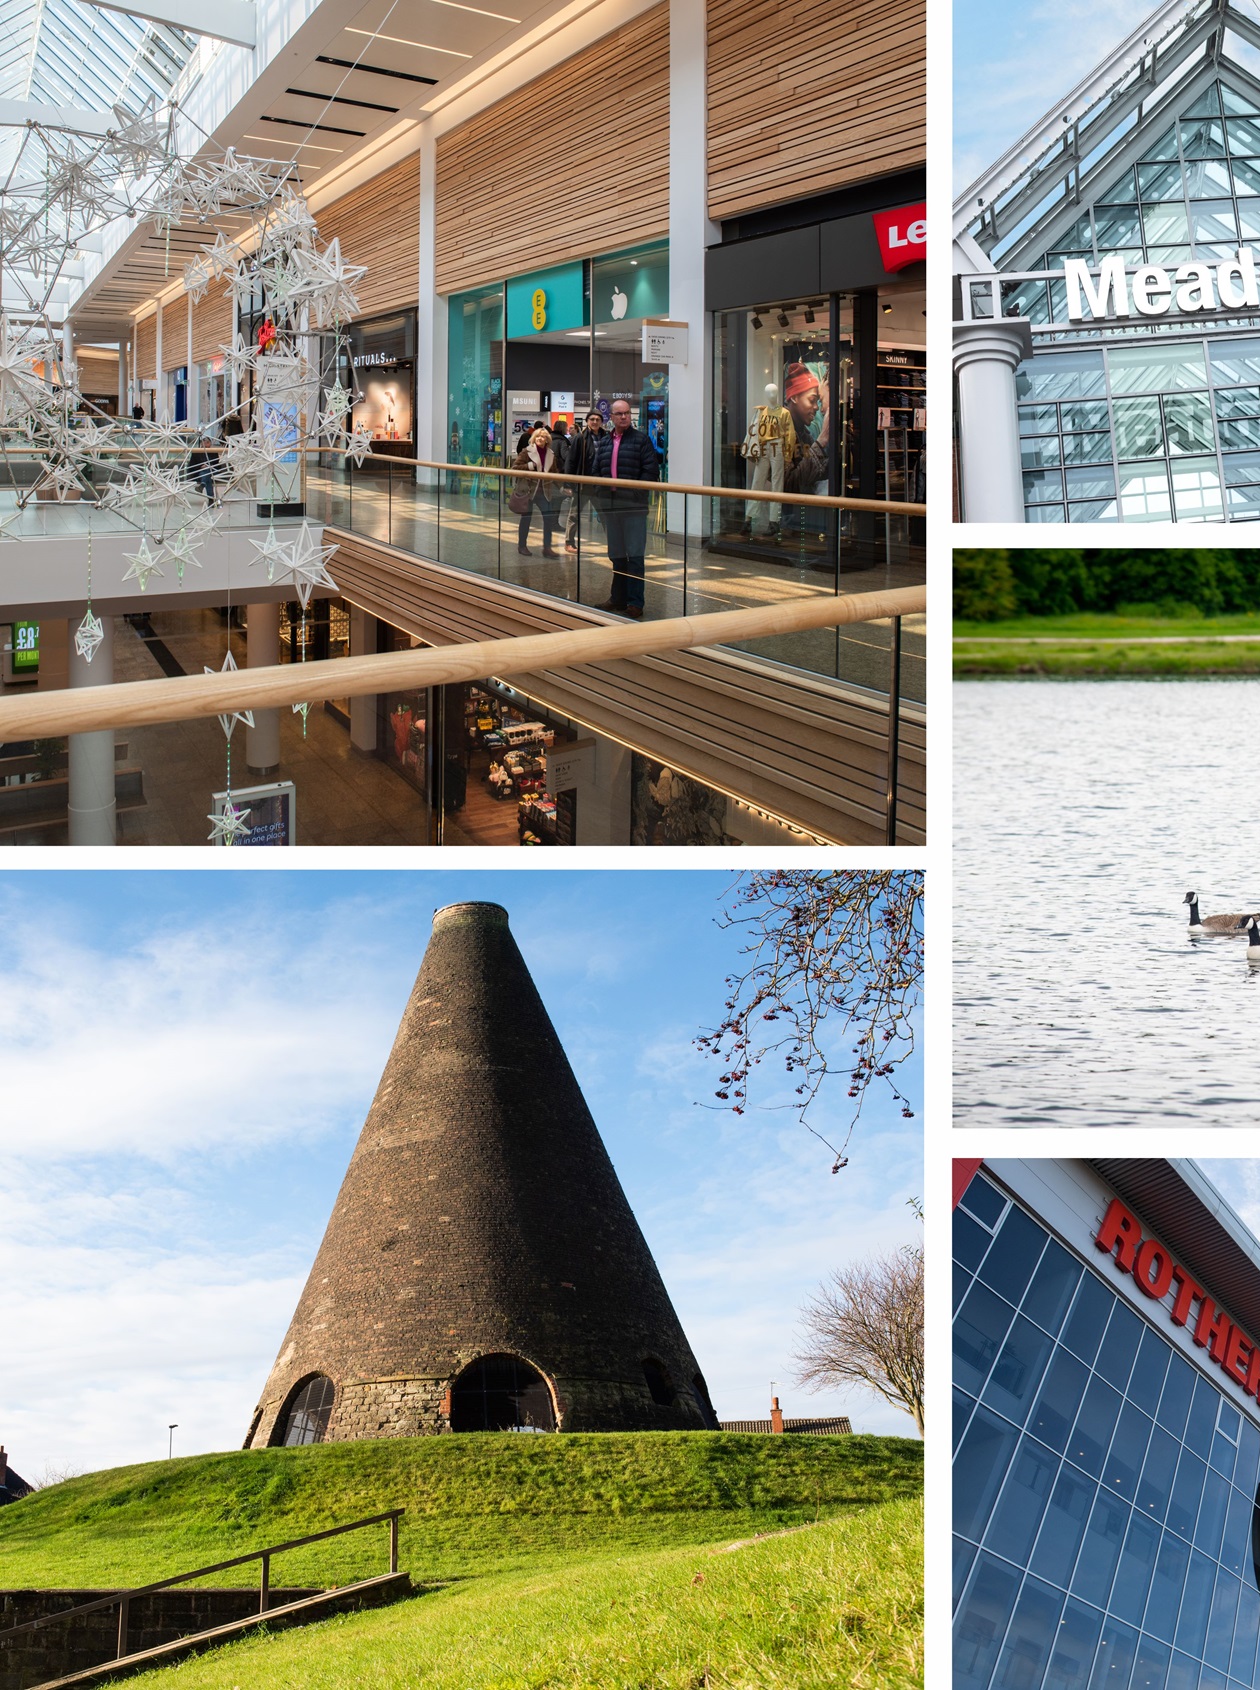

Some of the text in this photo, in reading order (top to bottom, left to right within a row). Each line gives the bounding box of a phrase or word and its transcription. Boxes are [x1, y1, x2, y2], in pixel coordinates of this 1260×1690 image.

[885, 355, 908, 364] SKINNY
[730, 441, 811, 459] TOGETHER
[269, 821, 285, 832] gifts
[252, 835, 265, 843] one
[267, 831, 286, 841] place
